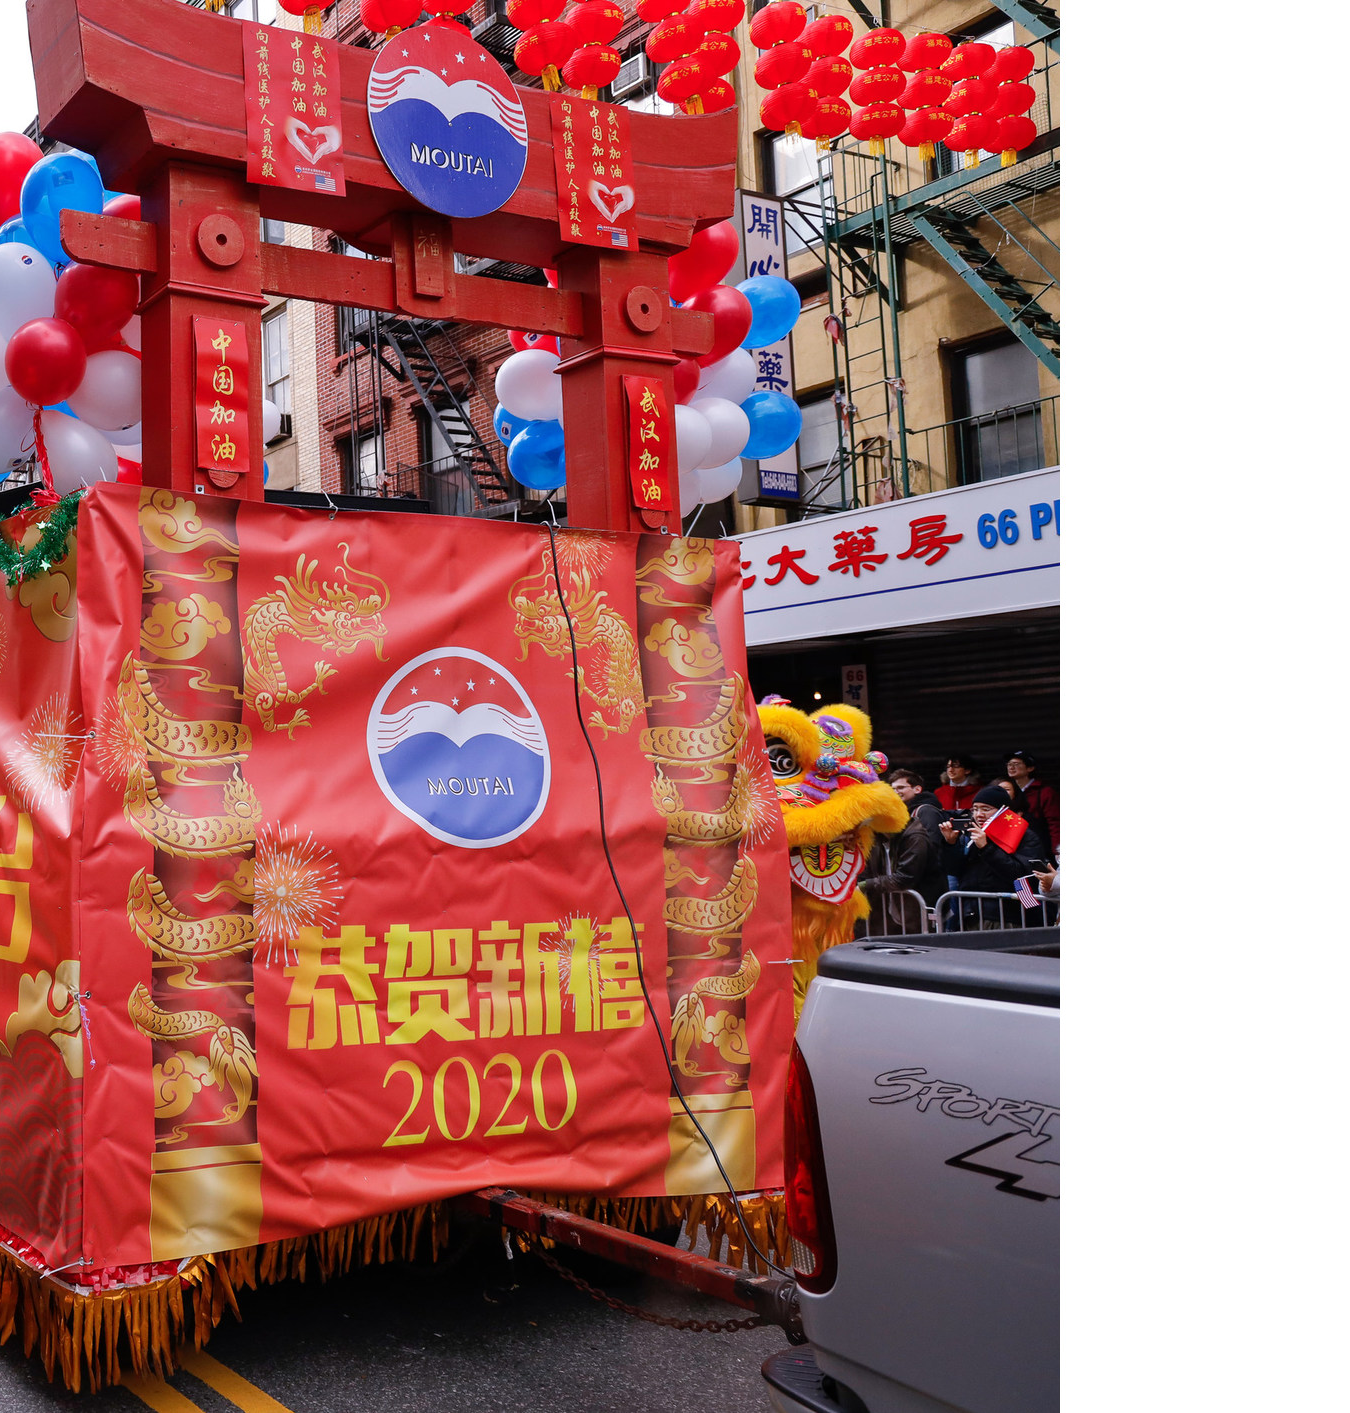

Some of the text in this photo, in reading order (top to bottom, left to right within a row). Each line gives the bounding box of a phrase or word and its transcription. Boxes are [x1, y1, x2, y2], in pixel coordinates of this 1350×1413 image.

[290, 36, 307, 113] 中国加油
[662, 64, 701, 87] 福建公所
[864, 36, 900, 48] 福建公所
[256, 29, 277, 178] 向前线医护人员致敬
[311, 42, 329, 118] 武汉加油
[863, 73, 900, 85] 福建公所
[589, 105, 605, 175] 中国加油
[607, 109, 623, 178] 武汉加油
[862, 109, 899, 121] 福建公所
[410, 142, 494, 178] MOUTAI
[561, 100, 583, 237] 向前线医护人员致敬
[210, 328, 236, 461] 中国加油
[639, 386, 661, 502] 武汉加油
[977, 508, 1019, 549] 66
[846, 670, 864, 682] 66
[426, 776, 515, 797] MOUTAI
[283, 918, 646, 1051] 恭贺新禧
[382, 1048, 578, 1148] 2020
[868, 1067, 1060, 1137] SPORT
